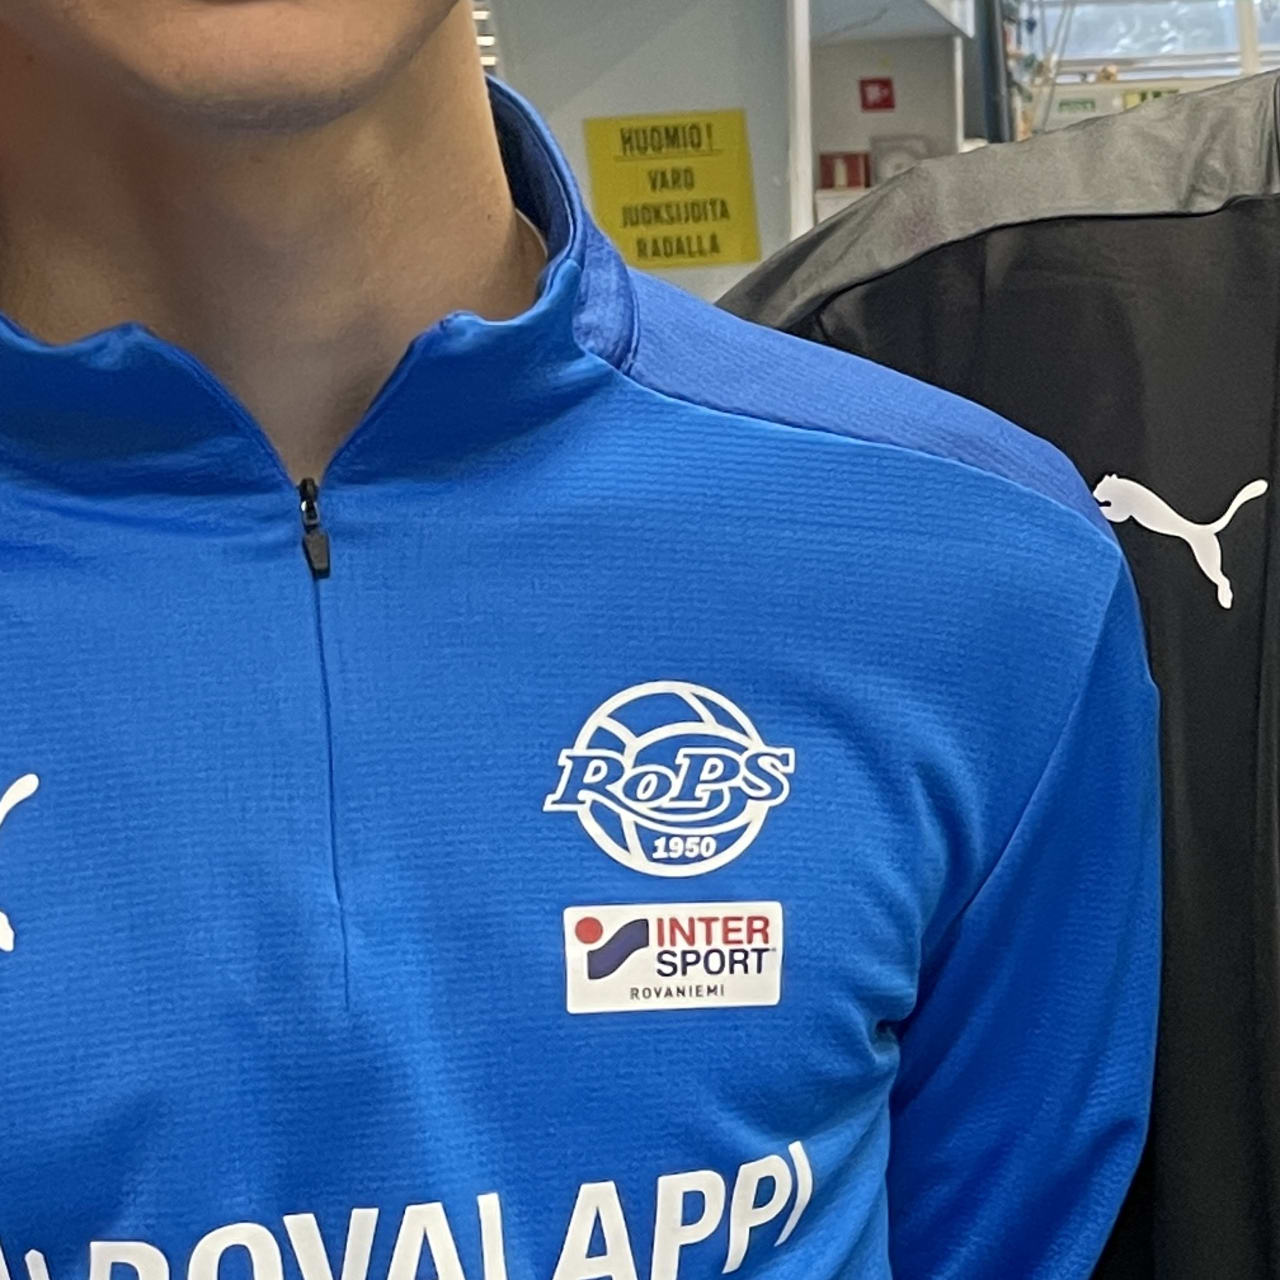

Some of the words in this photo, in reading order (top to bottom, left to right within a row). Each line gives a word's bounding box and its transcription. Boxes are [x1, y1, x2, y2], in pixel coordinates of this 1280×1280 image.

[620, 122, 713, 156] HUOMIO!
[648, 166, 695, 192] VARO
[621, 198, 730, 228] JUOKSIJOITA
[636, 231, 720, 259] RADALLA
[652, 836, 717, 859] 1950
[656, 916, 770, 947] INTER
[656, 949, 770, 978] SPORT
[630, 985, 725, 1000] ROVANIEMI
